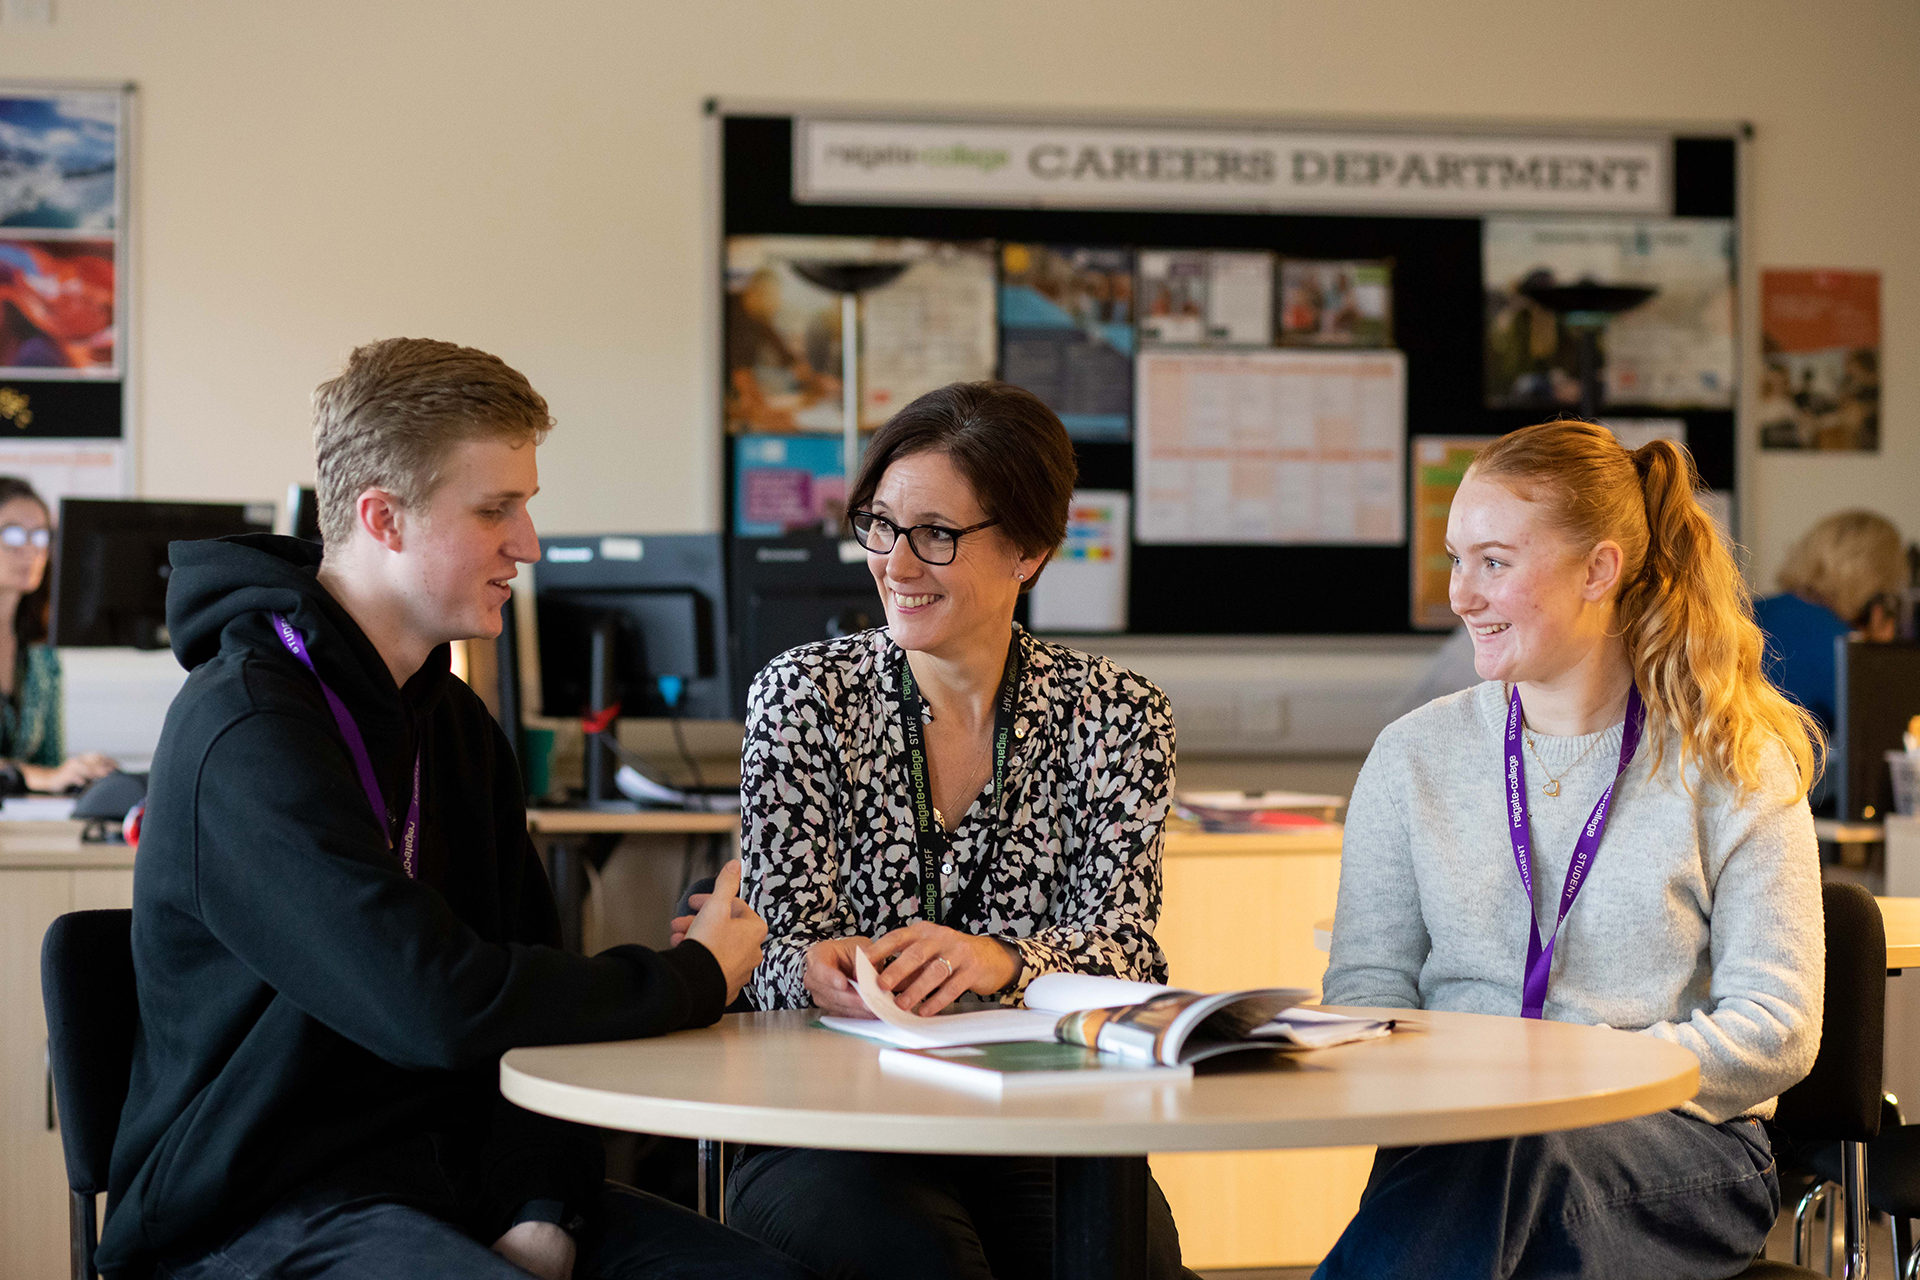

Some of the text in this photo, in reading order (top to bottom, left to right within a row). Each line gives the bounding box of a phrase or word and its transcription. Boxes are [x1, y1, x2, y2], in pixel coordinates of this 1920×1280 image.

[1028, 144, 1276, 184] CAREERS
[1292, 150, 1651, 193] DEPARTMENT
[1001, 685, 1015, 714] STAFF
[909, 715, 919, 745] STAFF
[1508, 700, 1518, 741] STUDENT
[925, 848, 935, 879] STAFF
[1517, 844, 1531, 891] STUDENT
[1565, 852, 1587, 900] STUDENT
